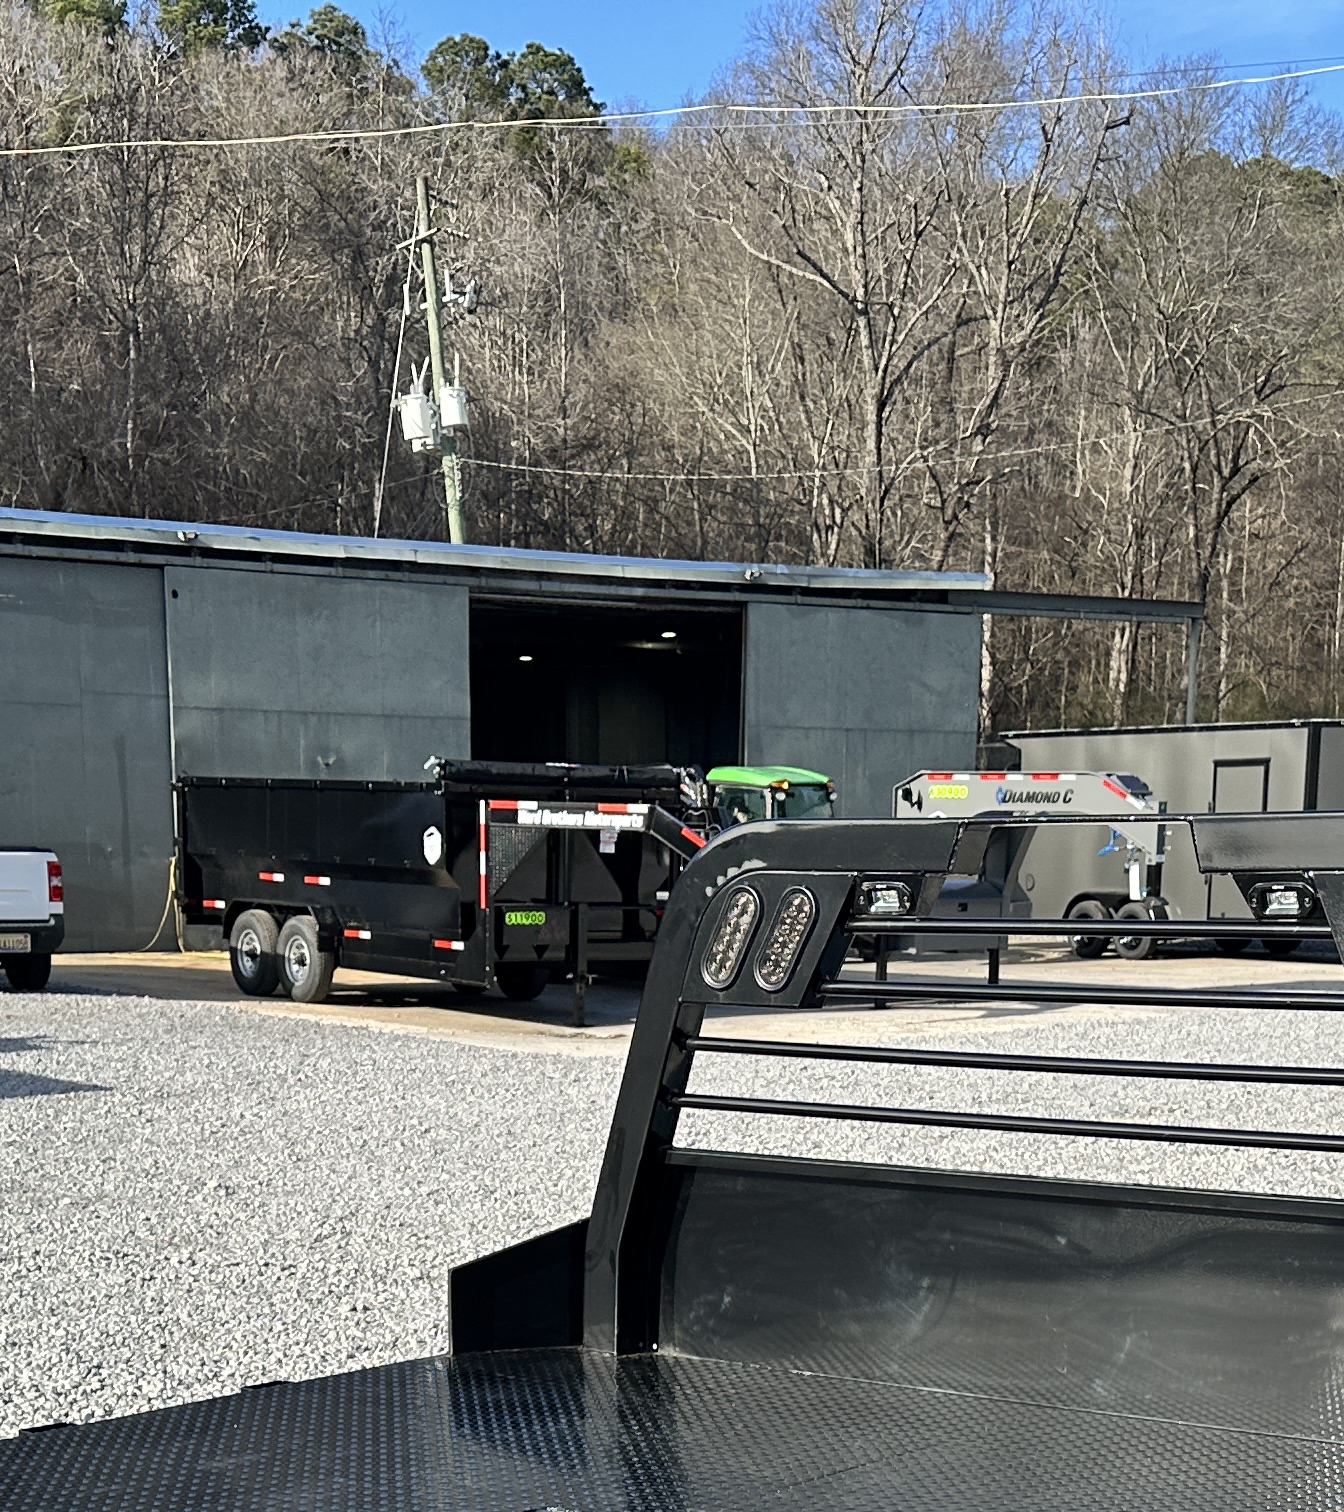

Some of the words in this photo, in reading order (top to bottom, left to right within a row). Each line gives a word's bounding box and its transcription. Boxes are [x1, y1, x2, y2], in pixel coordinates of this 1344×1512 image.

[1002, 789, 1061, 804] DIAMOND
[1063, 788, 1074, 804] C
[506, 912, 544, 924] $11900
